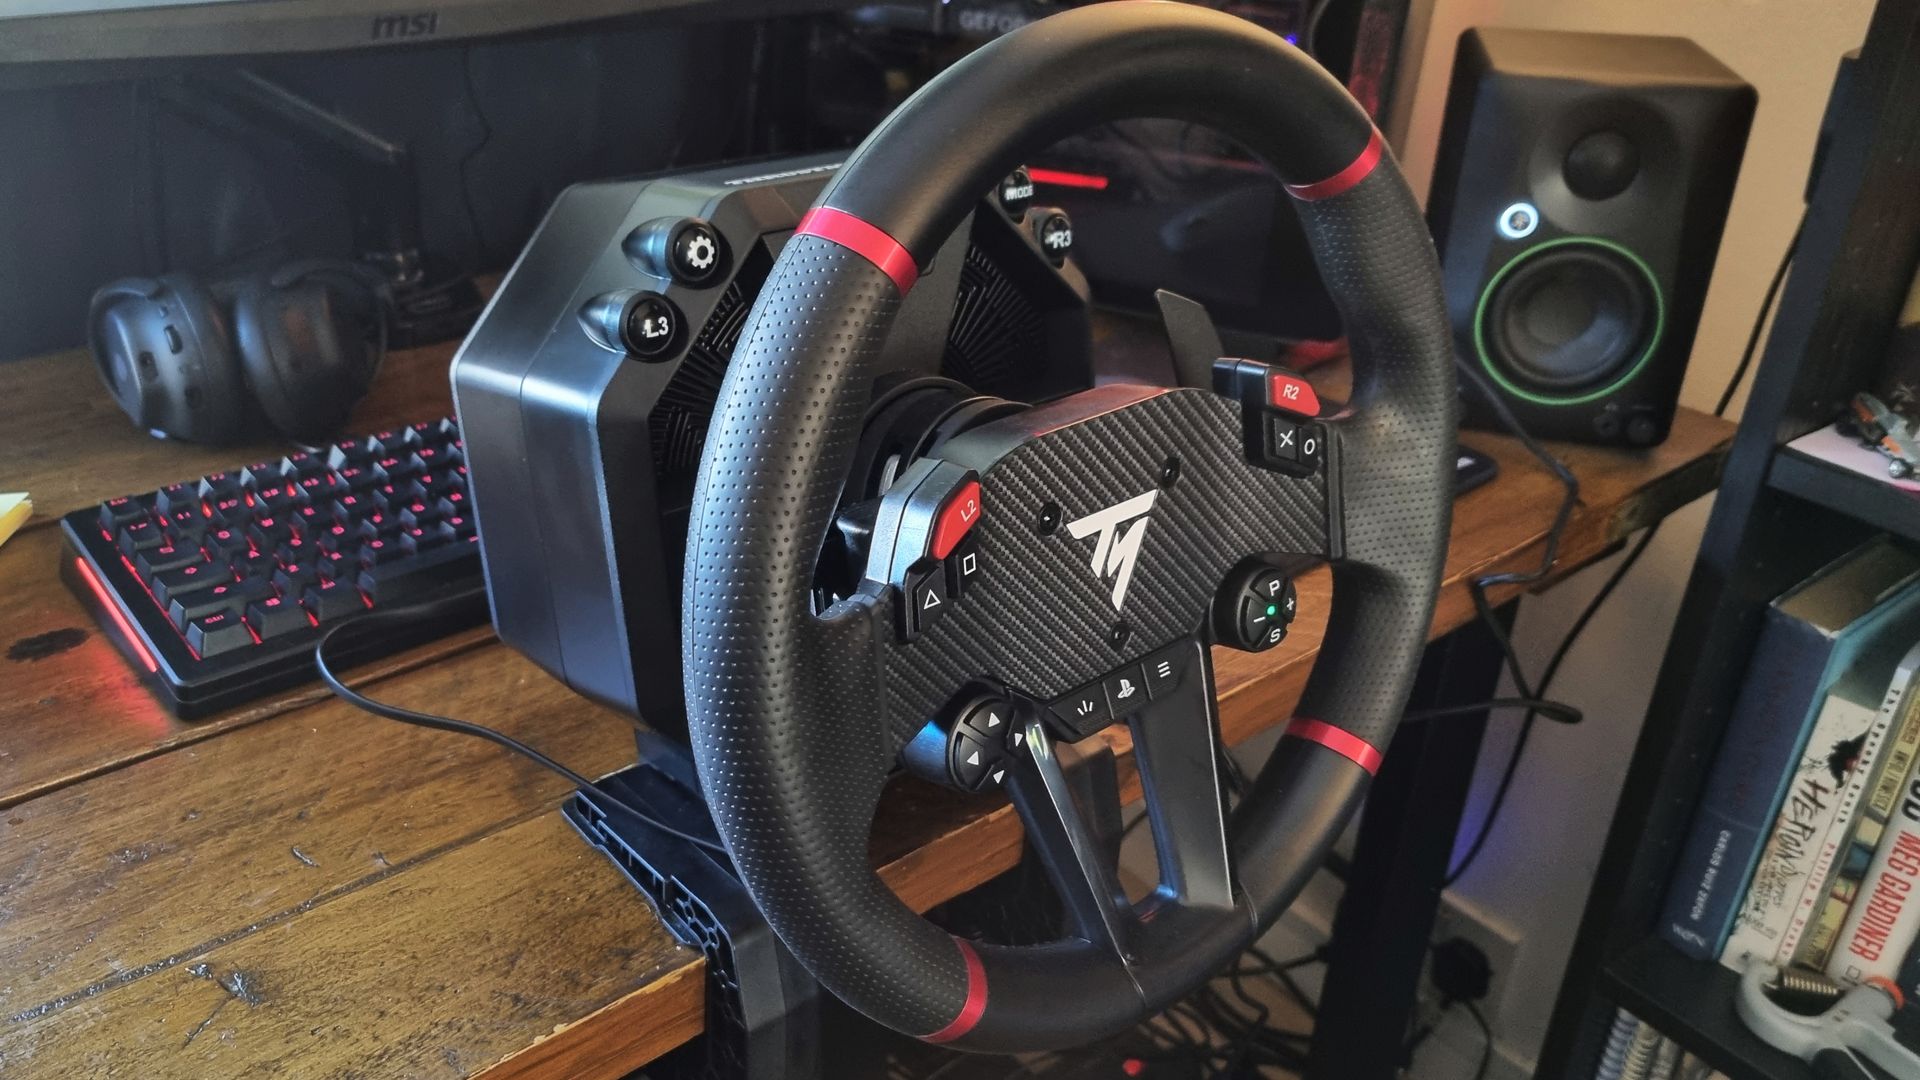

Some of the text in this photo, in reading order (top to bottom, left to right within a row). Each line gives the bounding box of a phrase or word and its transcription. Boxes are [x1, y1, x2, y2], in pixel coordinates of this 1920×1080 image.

[371, 11, 439, 39] msi
[1005, 184, 1034, 200] MODE
[645, 316, 669, 338] L3
[1282, 383, 1300, 400] R2
[960, 499, 978, 523] L2
[1268, 578, 1281, 597] P
[1269, 627, 1282, 644] S
[1774, 777, 1831, 864] HEROIN
[1887, 829, 1920, 877] MEG
[1848, 871, 1912, 962] GARDINER
